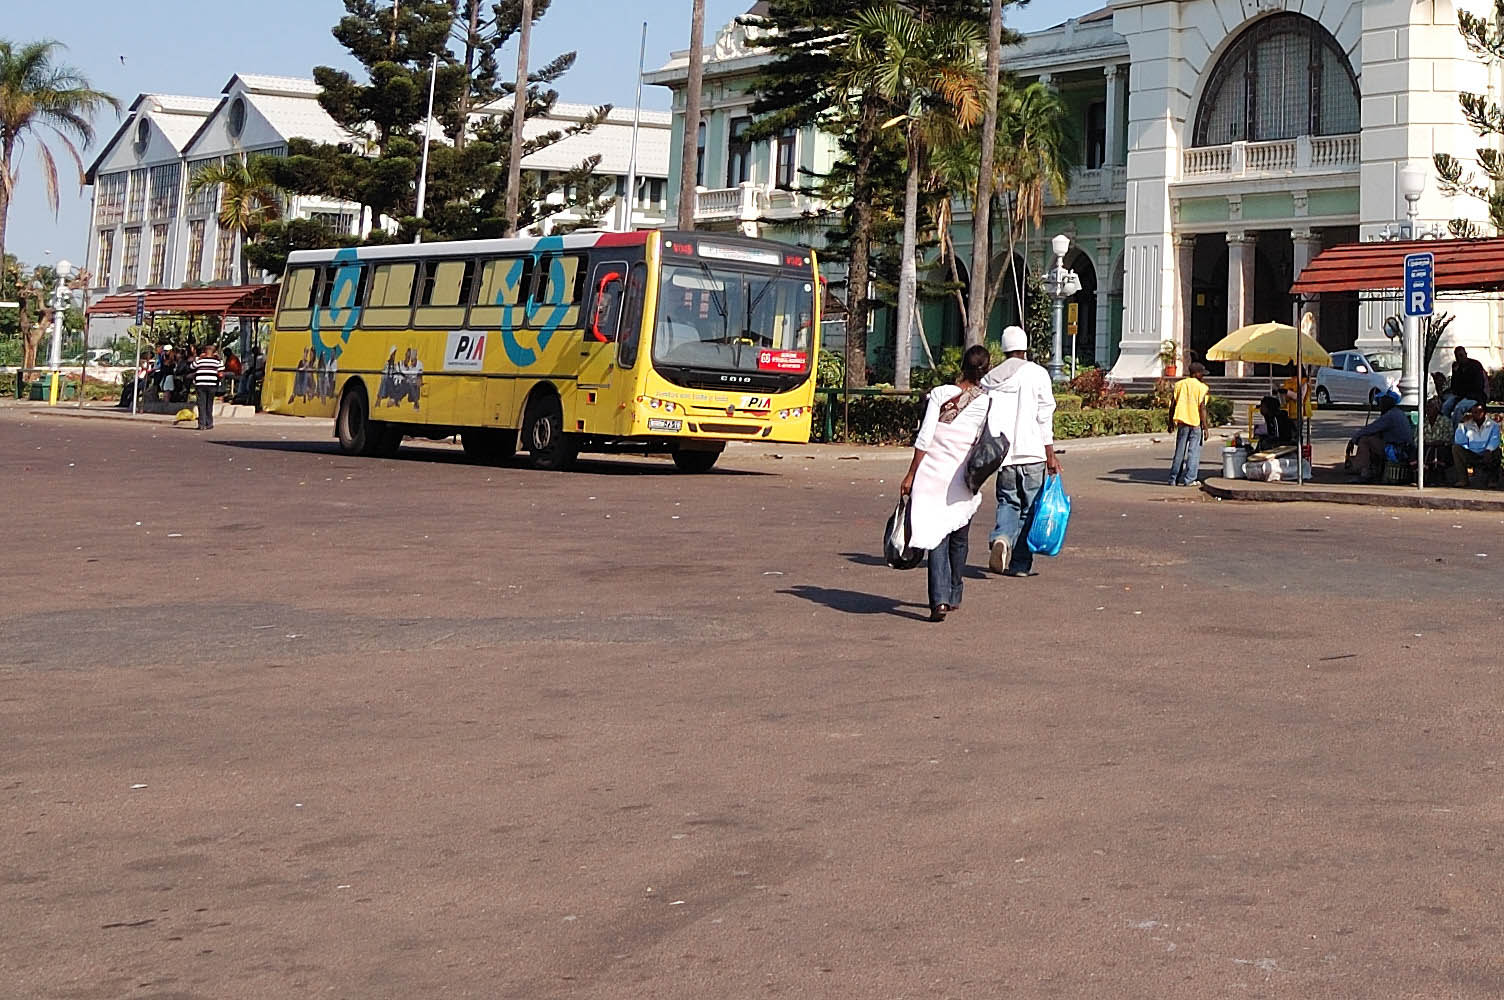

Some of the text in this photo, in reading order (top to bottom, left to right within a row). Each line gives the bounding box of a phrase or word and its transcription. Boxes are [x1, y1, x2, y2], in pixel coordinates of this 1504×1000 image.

[1411, 291, 1426, 313] R
[454, 335, 485, 361] PIA
[748, 396, 771, 409] PIA
